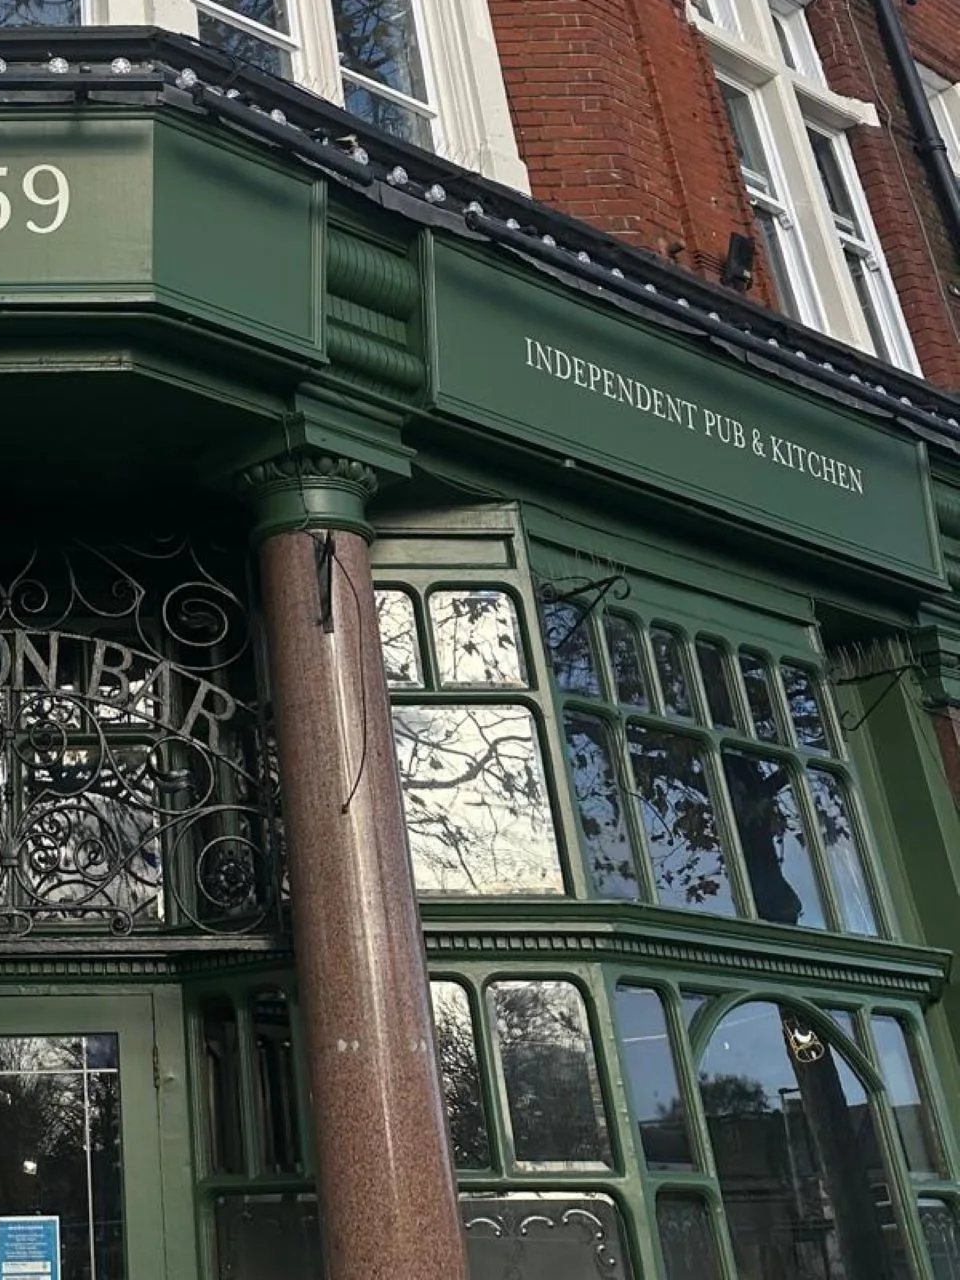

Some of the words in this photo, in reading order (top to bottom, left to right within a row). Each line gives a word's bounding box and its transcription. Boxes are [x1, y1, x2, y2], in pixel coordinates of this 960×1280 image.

[524, 337, 697, 431] INDEPENDENT
[703, 408, 746, 449] PUB
[752, 428, 767, 458] &
[770, 435, 864, 495] KITCHEN
[88, 637, 236, 755] BAR
